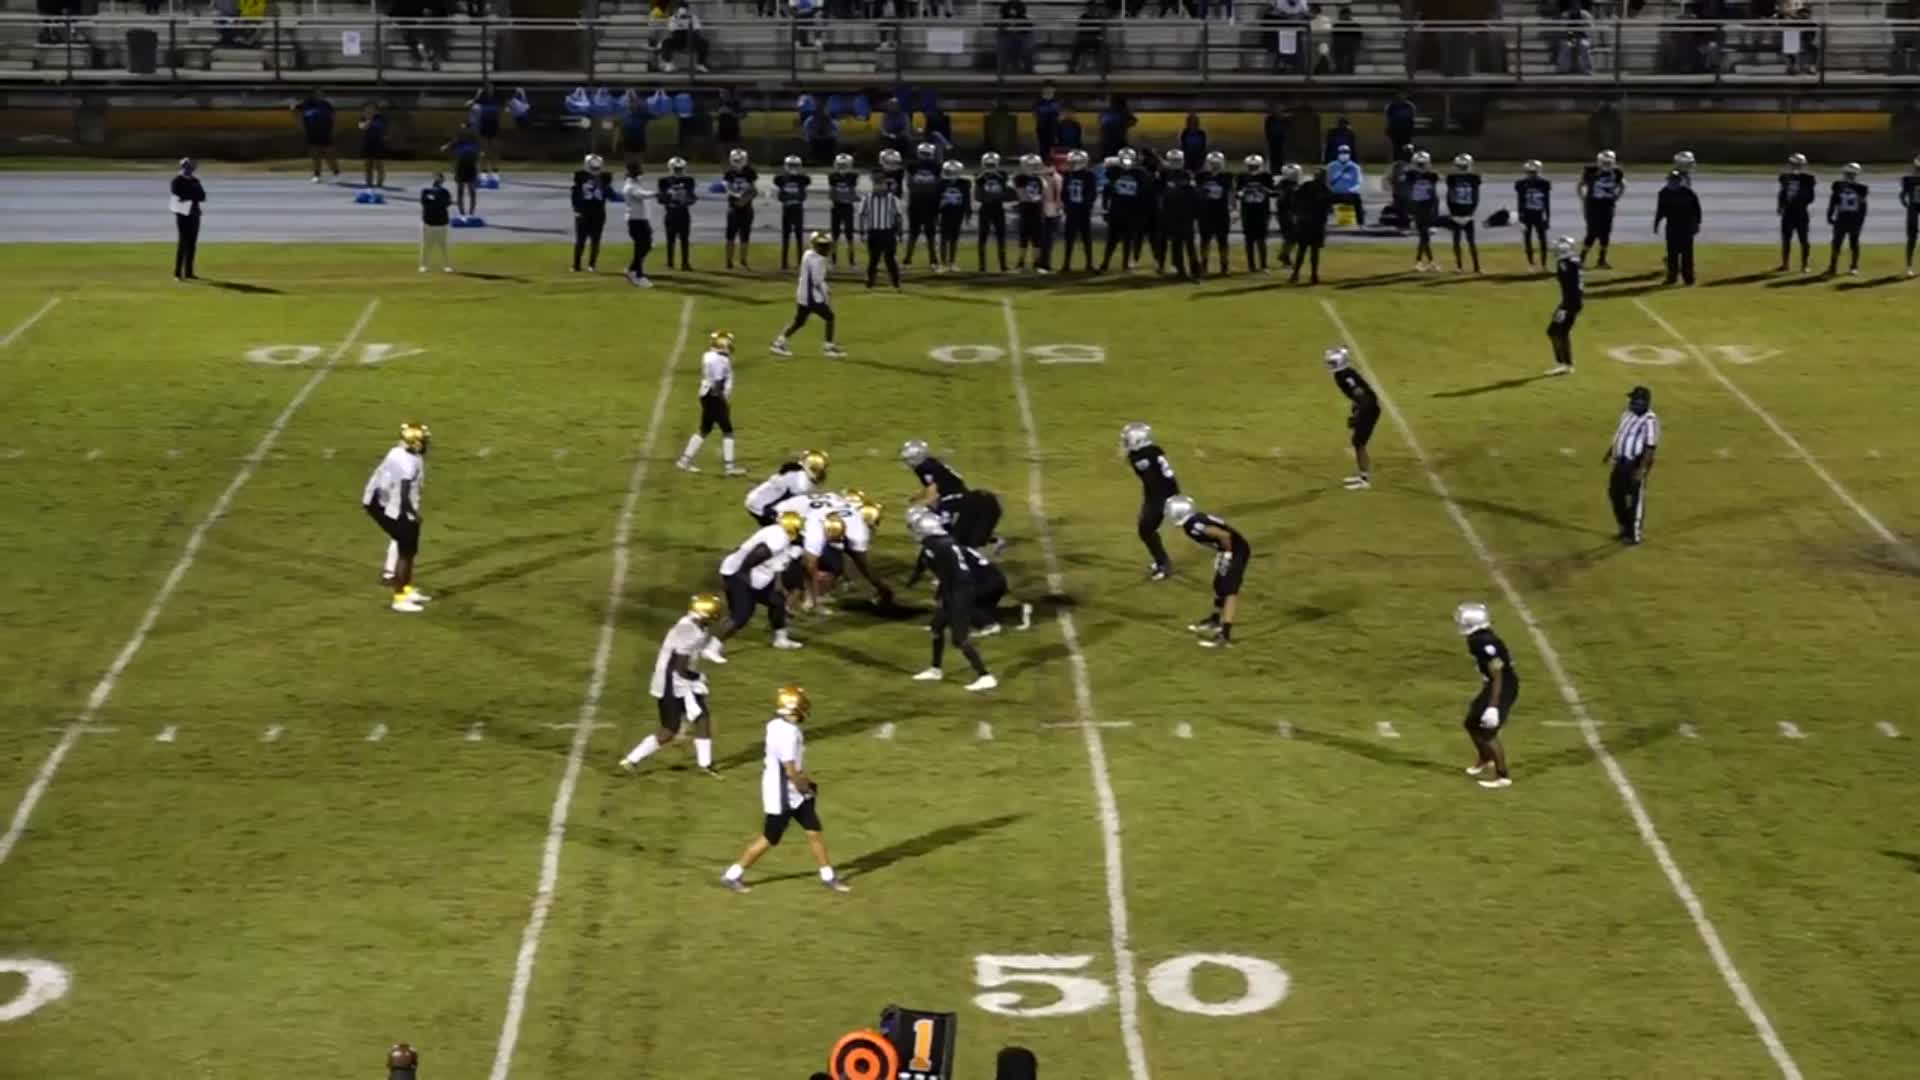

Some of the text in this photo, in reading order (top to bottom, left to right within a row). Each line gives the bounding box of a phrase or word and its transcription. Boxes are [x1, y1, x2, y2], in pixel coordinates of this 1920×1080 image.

[929, 344, 1105, 364] 50
[972, 953, 1290, 1016] 50
[908, 1018, 934, 1072] 1
